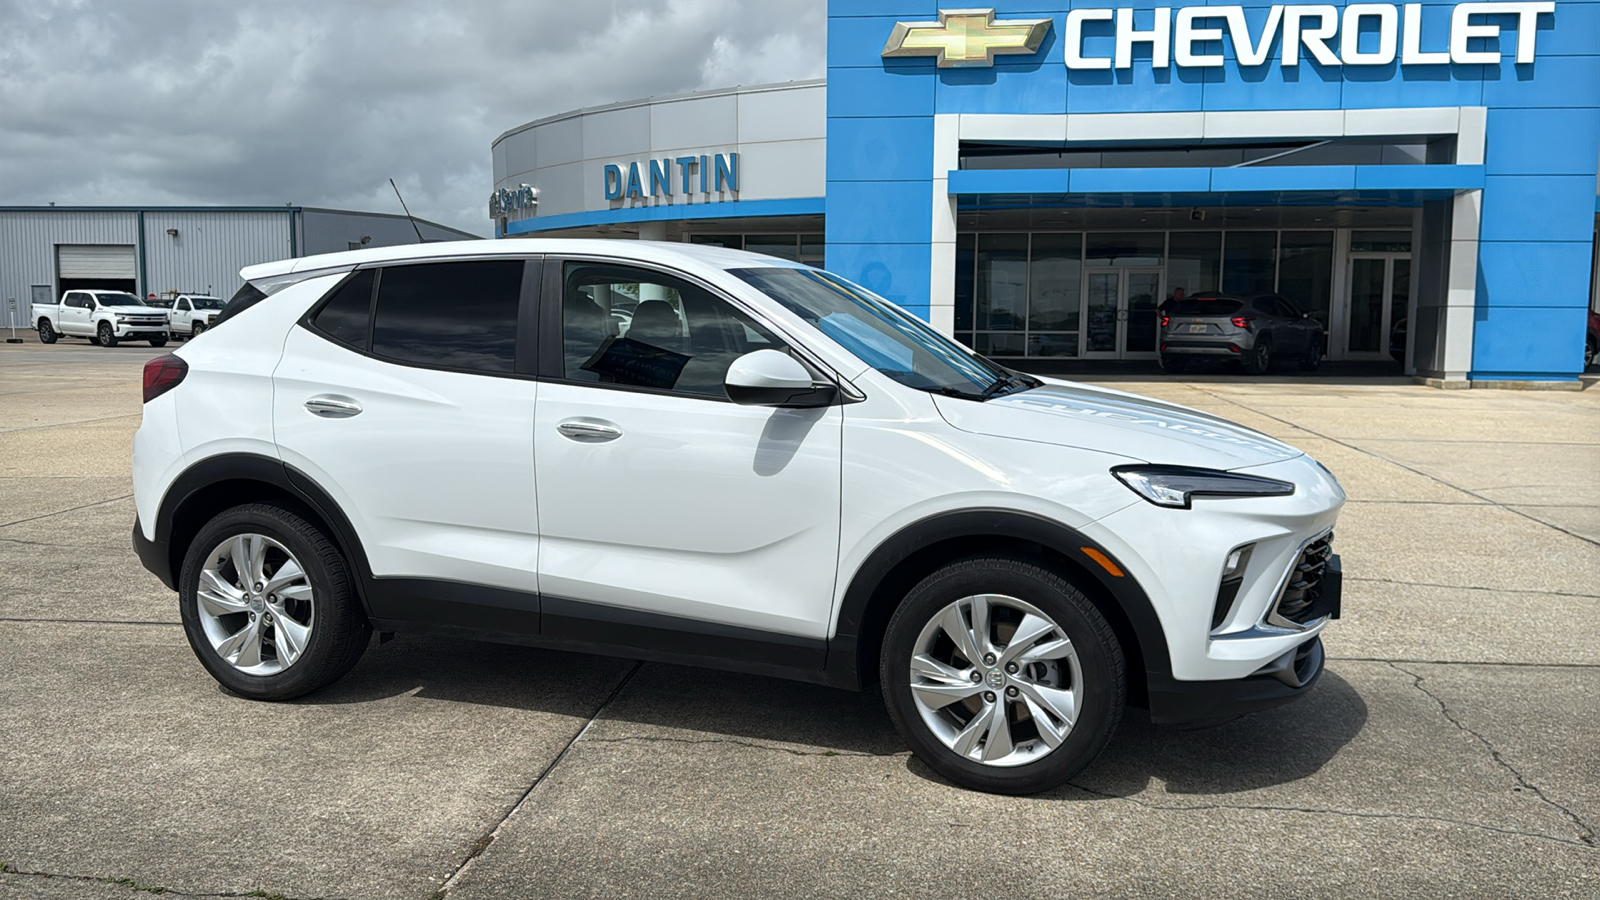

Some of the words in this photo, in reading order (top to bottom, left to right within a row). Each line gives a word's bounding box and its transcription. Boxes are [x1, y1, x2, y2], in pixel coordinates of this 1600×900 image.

[1065, 1, 1555, 70] CHEVROLET
[501, 183, 536, 211] Service
[604, 153, 739, 201] DANTIN
